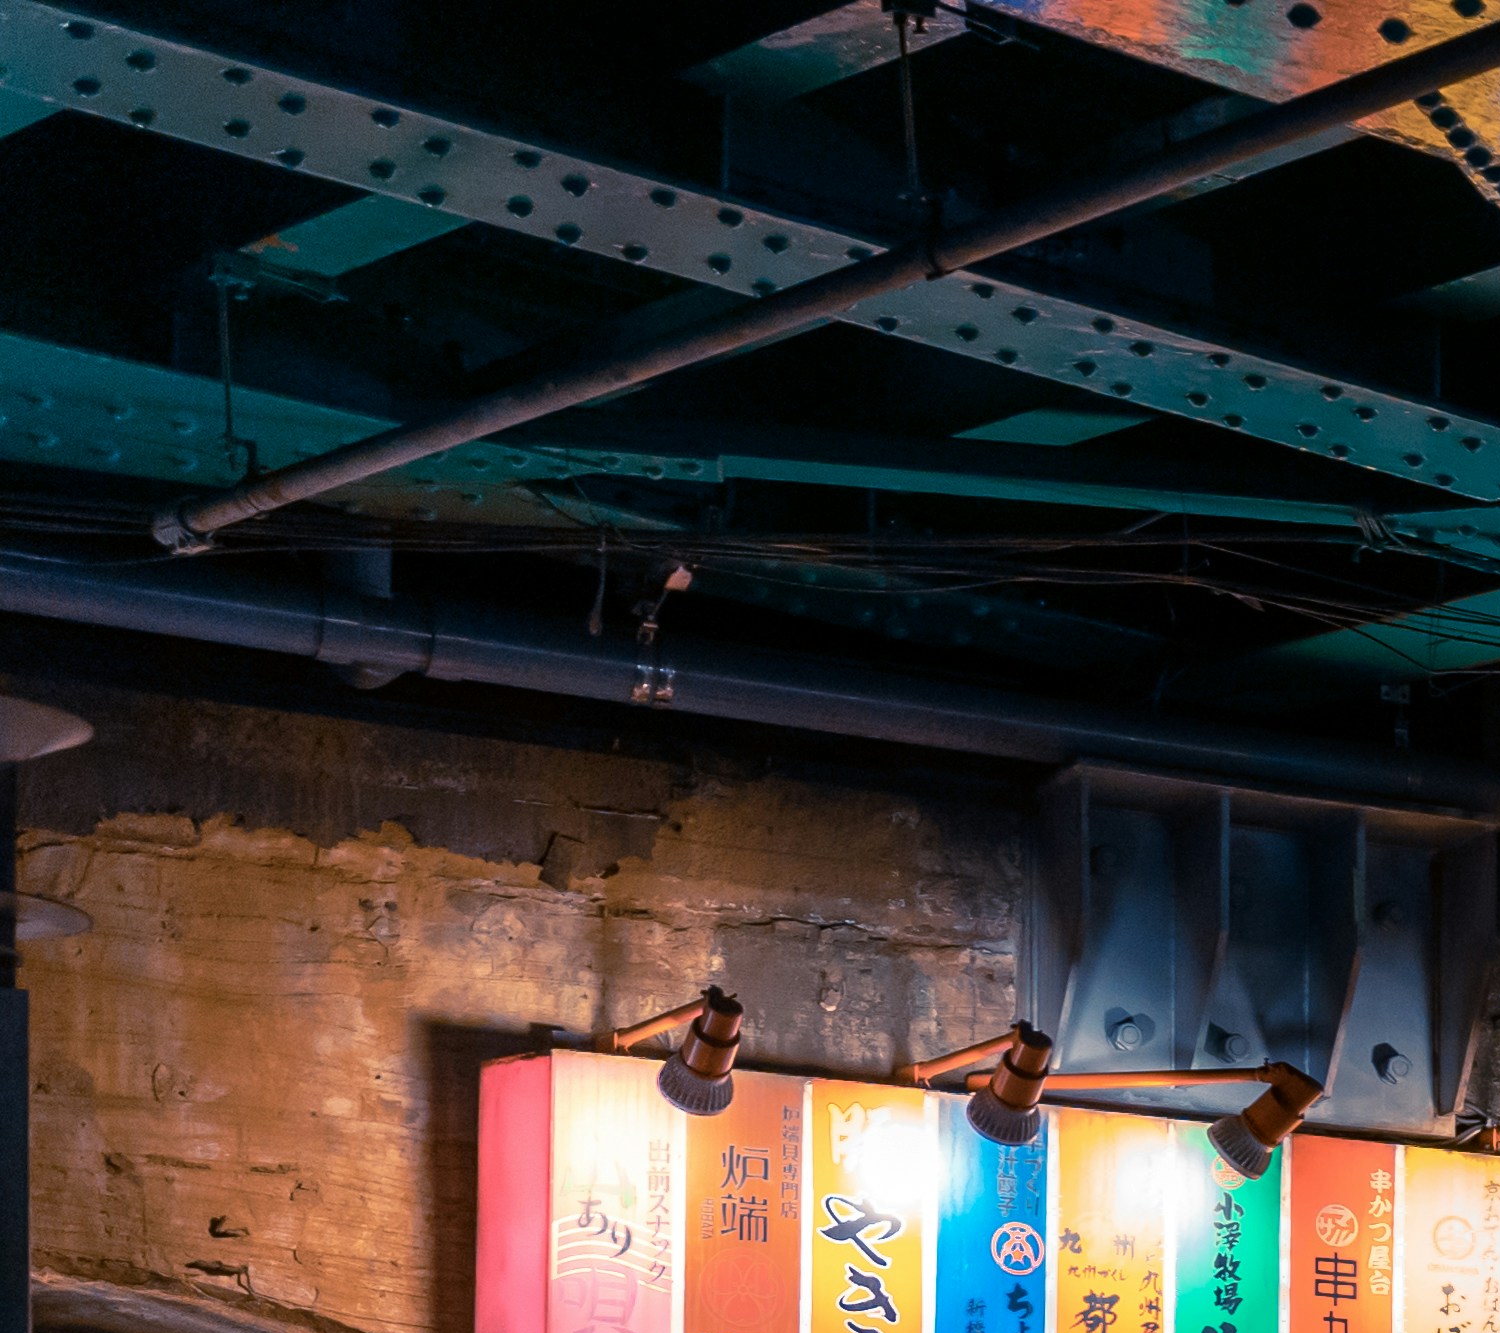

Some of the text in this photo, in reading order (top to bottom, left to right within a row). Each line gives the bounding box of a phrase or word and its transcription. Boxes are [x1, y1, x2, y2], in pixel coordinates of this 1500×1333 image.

[647, 1138, 671, 1284] 出前スナック
[720, 1144, 770, 1243] 炉端
[1212, 1191, 1244, 1316] 小澤牧場
[1367, 1167, 1393, 1296] 串かつ屋台
